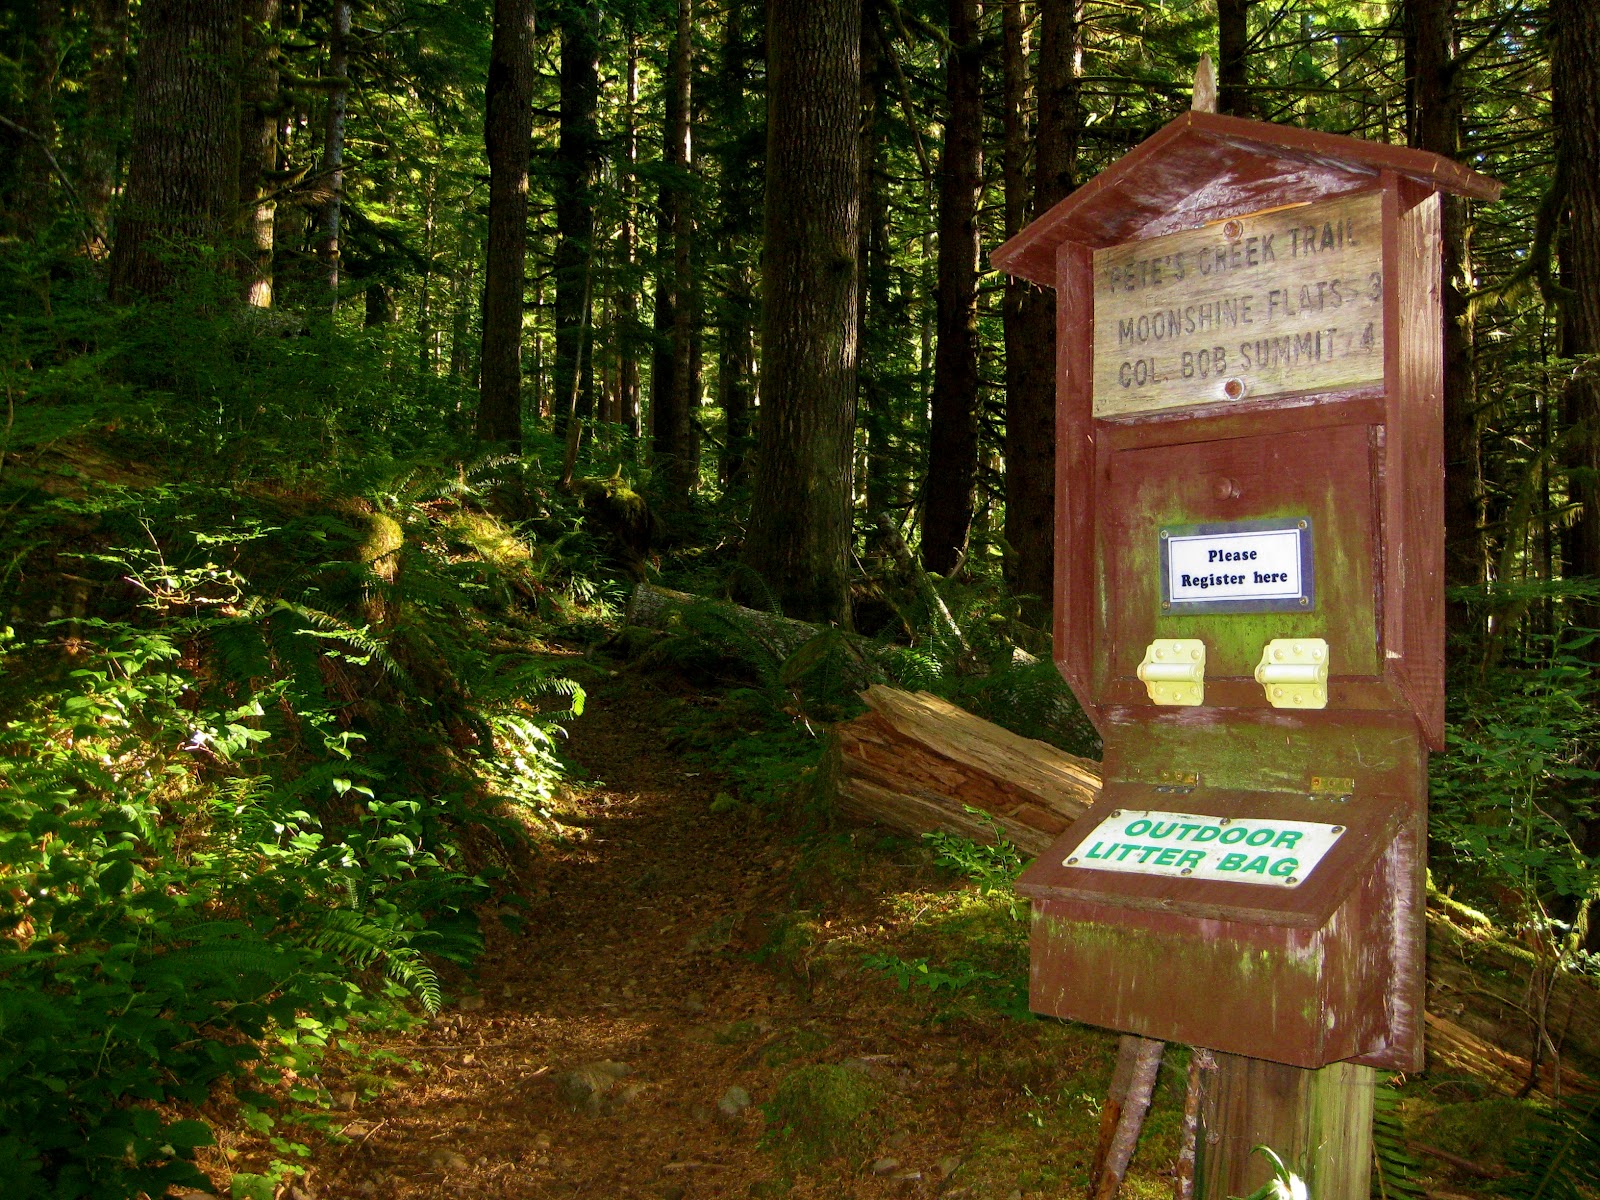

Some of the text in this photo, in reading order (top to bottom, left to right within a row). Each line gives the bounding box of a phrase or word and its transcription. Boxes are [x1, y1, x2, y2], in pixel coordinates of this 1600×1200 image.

[1109, 217, 1359, 293] PETE'S CREEK TRAIL
[1118, 295, 1254, 345] MOONSHINE
[1267, 278, 1342, 321] FLATS
[1181, 346, 1227, 379] BOB
[1240, 327, 1337, 371] SUMMIT
[1359, 321, 1376, 352] 4
[1208, 549, 1258, 563] Please
[1181, 571, 1288, 589] Register here
[1124, 819, 1304, 850] OUTDOOR
[1085, 841, 1300, 877] LITTER BAG
